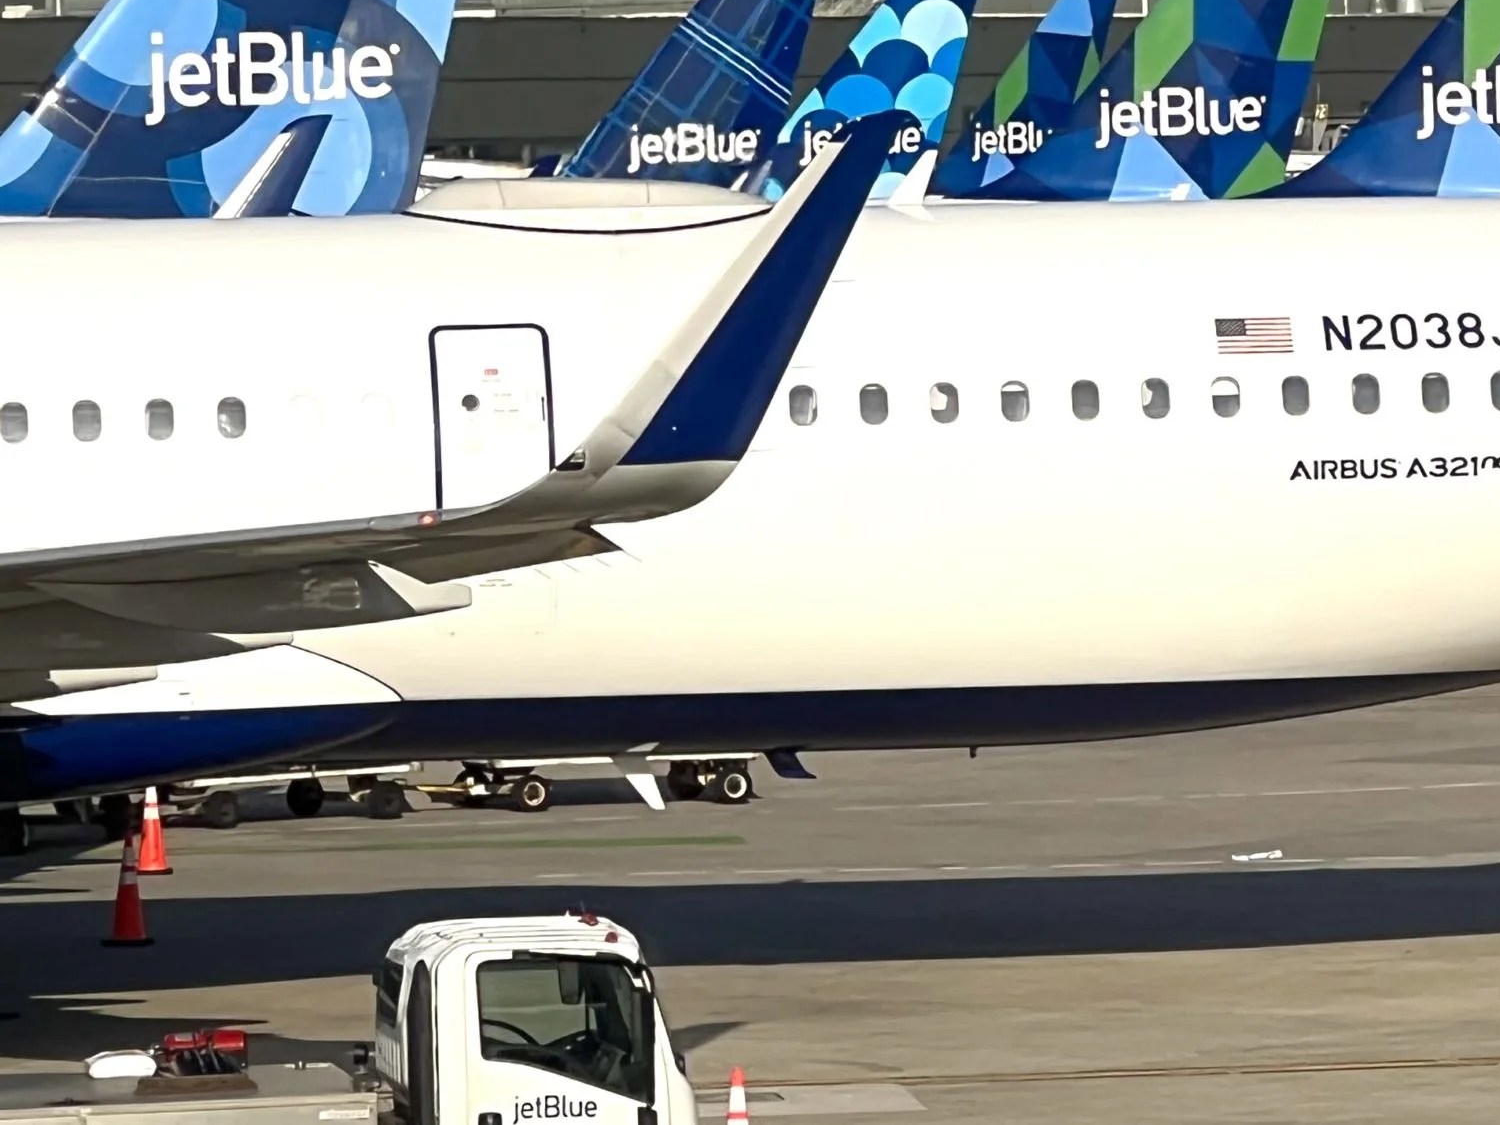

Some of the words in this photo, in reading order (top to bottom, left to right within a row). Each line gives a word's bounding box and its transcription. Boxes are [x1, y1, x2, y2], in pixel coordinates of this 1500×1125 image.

[145, 31, 401, 126] jetBlue
[1095, 86, 1267, 149] jetBlue
[627, 123, 761, 174] jetBlue
[1290, 458, 1398, 481] AIRBUS
[513, 1094, 598, 1125] jetBlue
